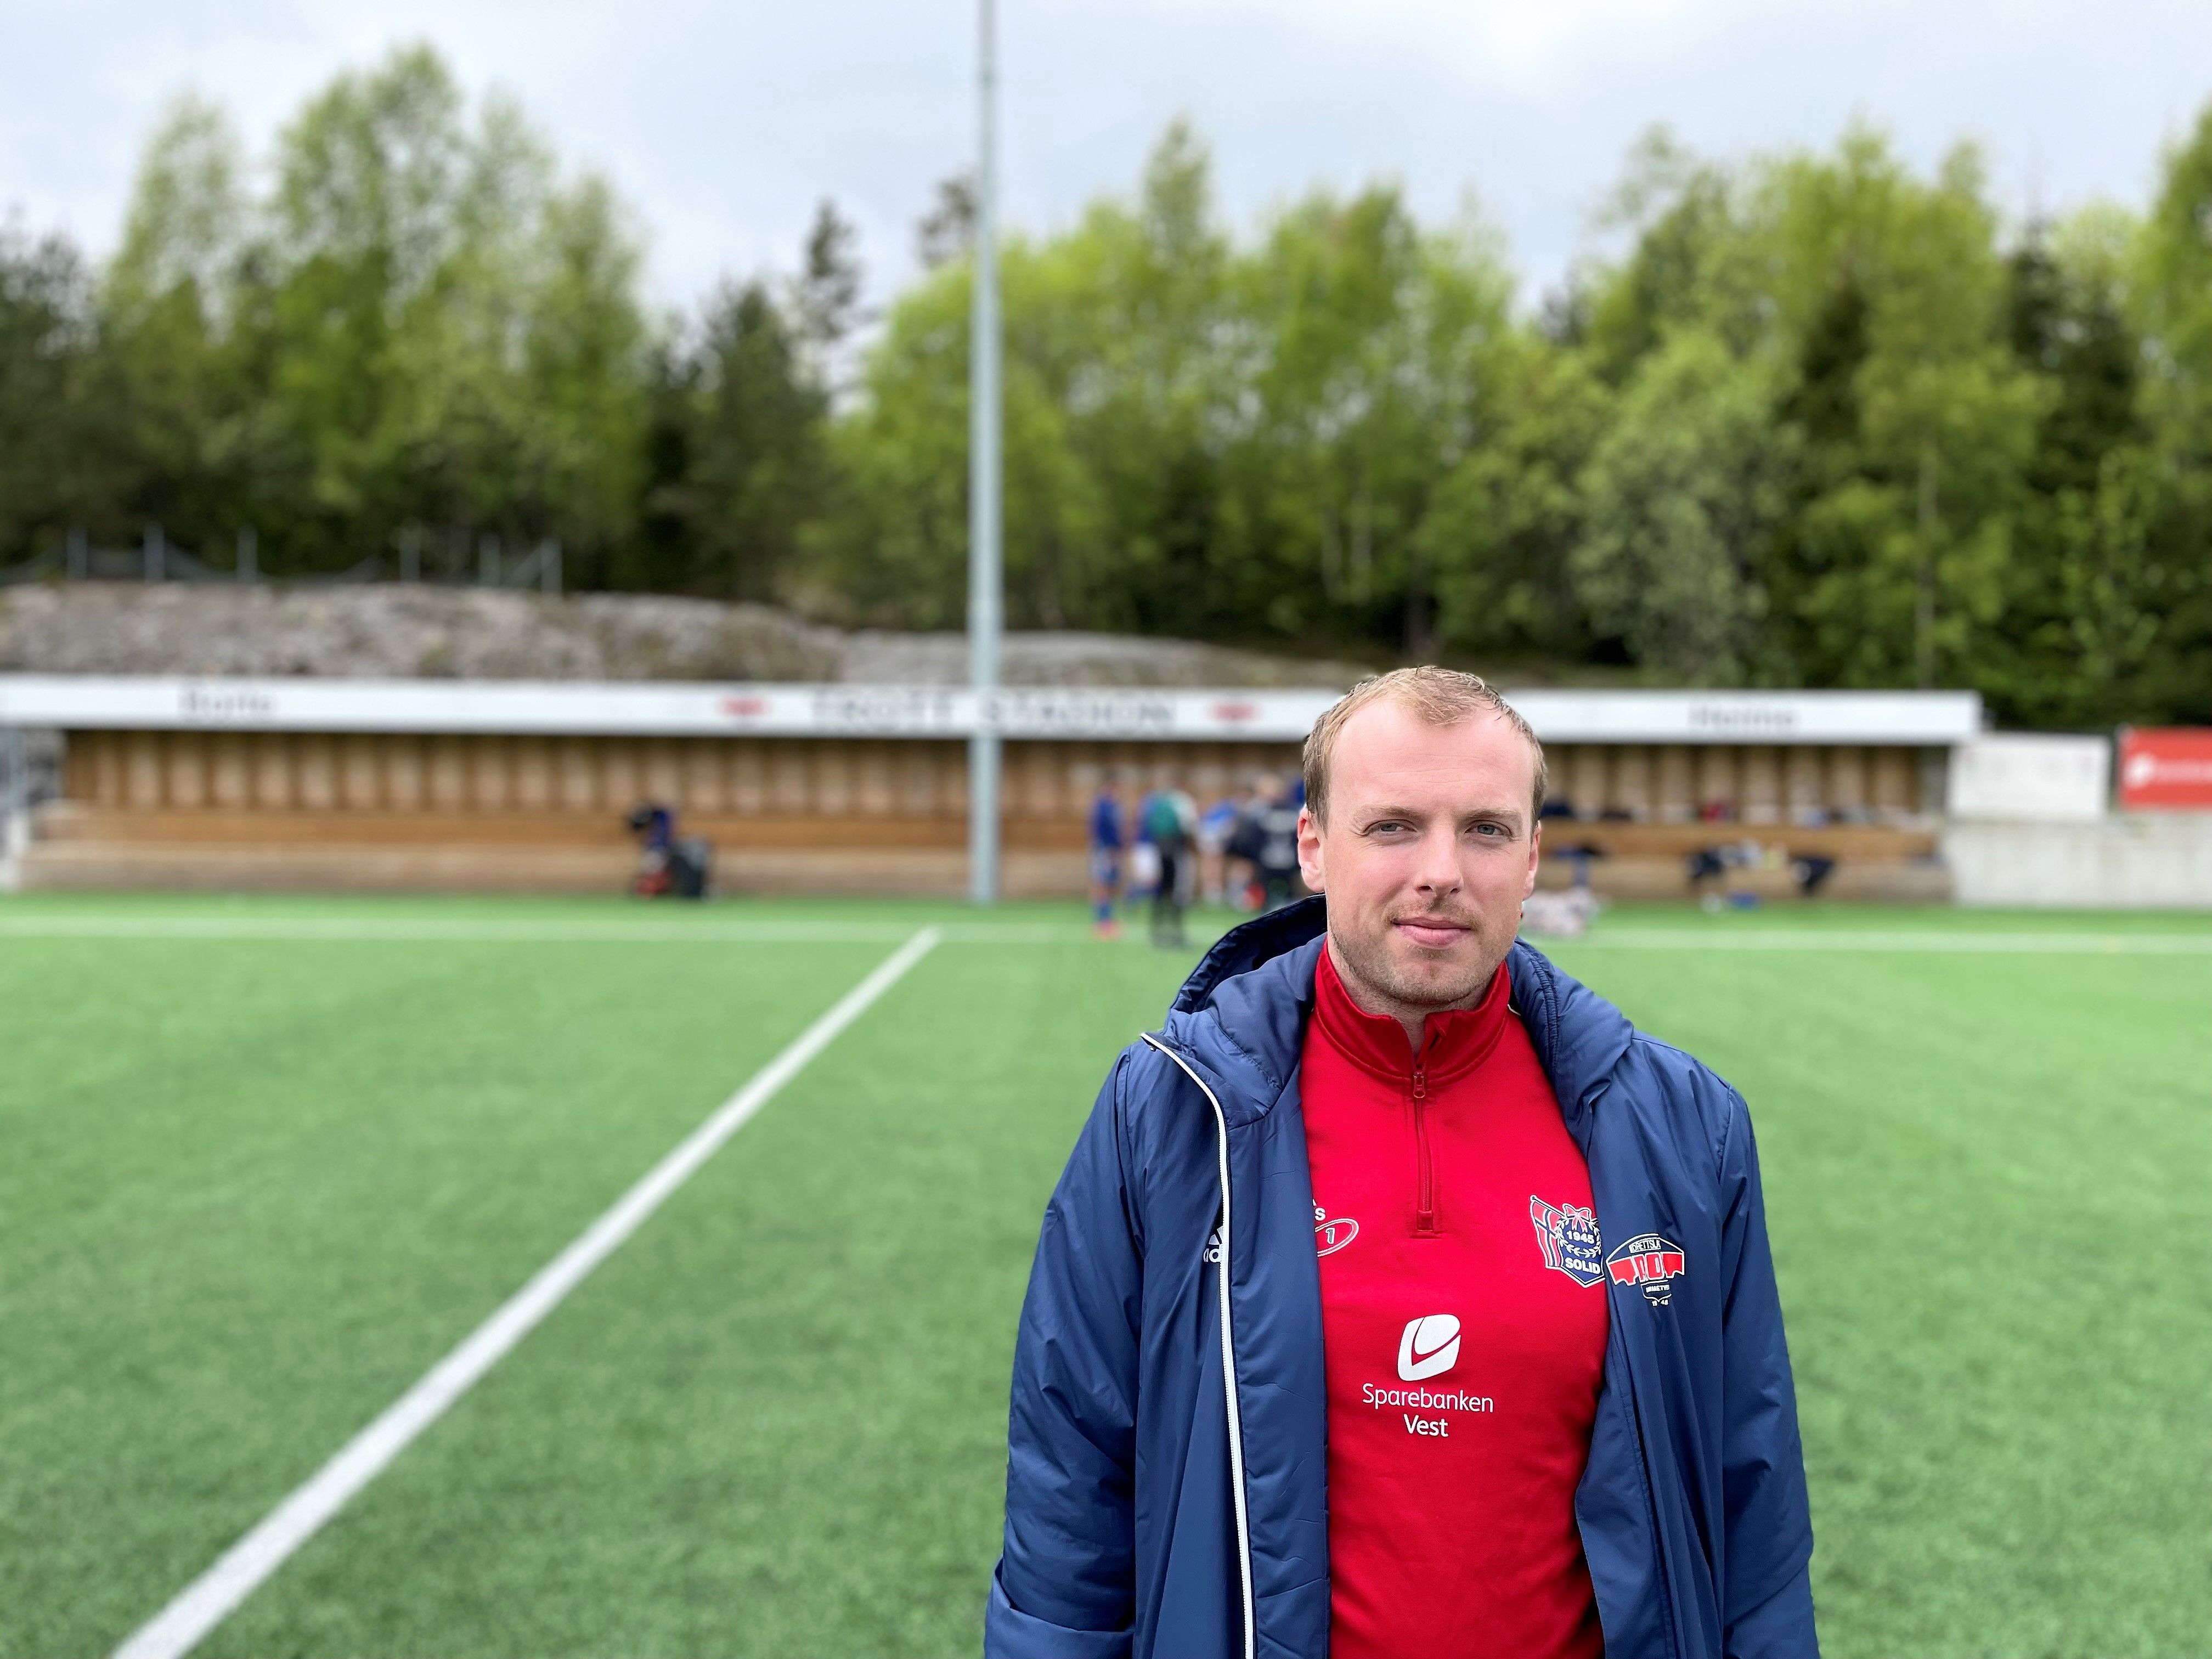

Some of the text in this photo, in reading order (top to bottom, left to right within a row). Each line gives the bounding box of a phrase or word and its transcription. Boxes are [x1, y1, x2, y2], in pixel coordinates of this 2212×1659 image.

[1566, 1230, 1594, 1245] 1945
[1565, 1257, 1601, 1274] SOLID
[1362, 1383, 1493, 1413] Sparebanken
[1403, 1413, 1449, 1437] Vest
